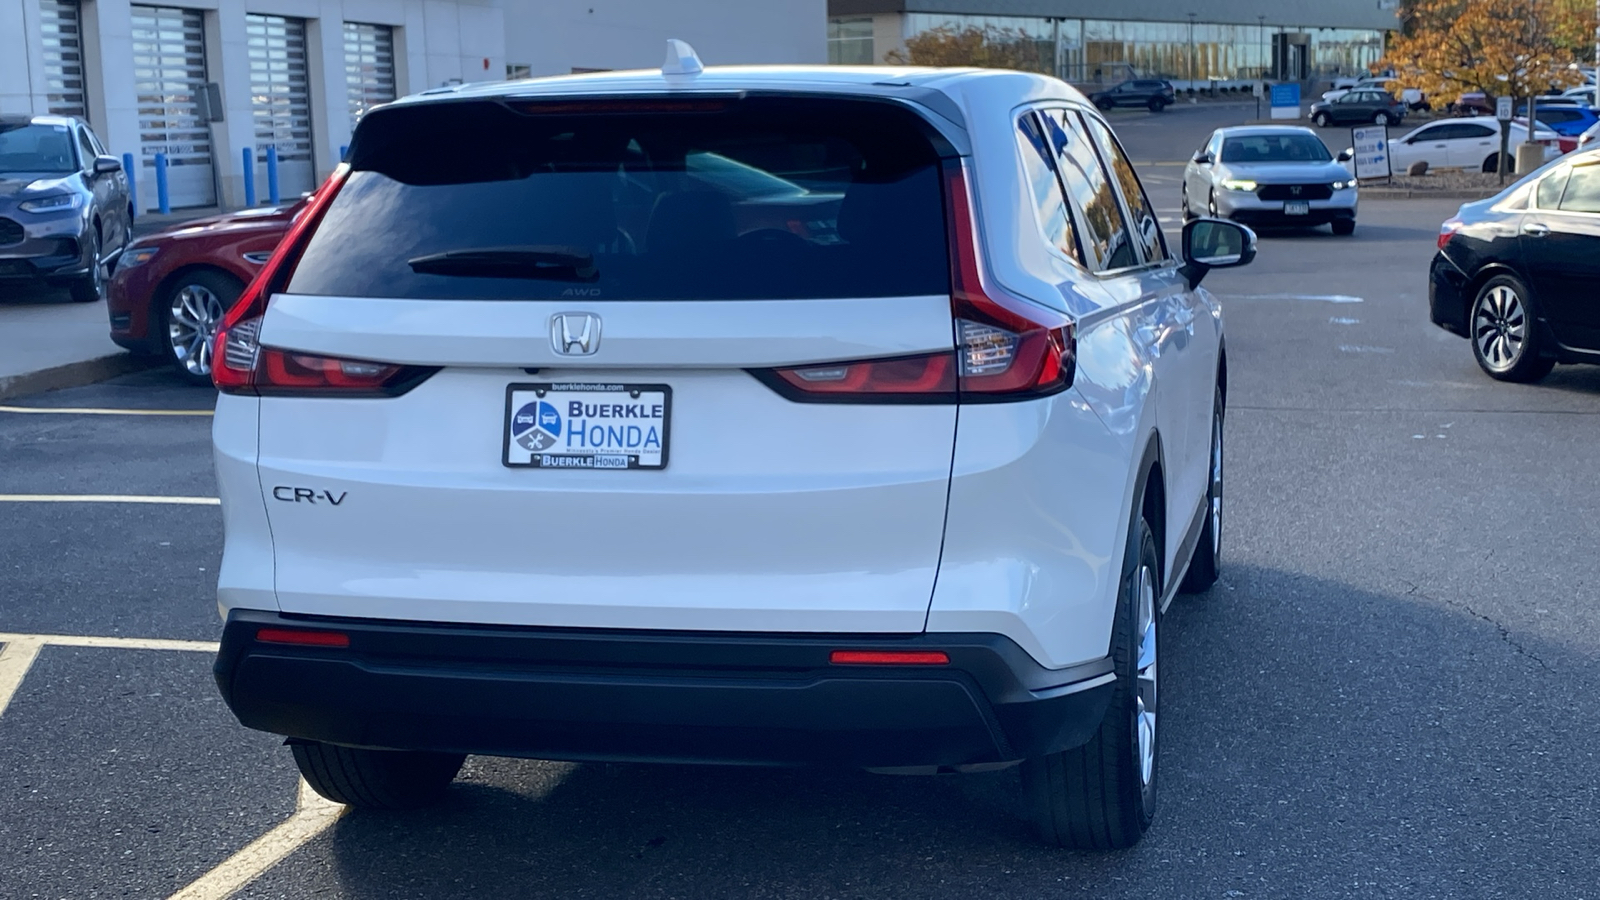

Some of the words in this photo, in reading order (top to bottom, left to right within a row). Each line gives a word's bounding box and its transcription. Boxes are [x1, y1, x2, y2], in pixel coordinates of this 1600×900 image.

[562, 288, 601, 297] AWD
[551, 382, 624, 392] buerklehonda.com
[568, 400, 663, 419] BUERKLE
[566, 419, 661, 449] HONDA
[542, 455, 594, 467] BUERKLE
[595, 456, 627, 467] HONDA
[272, 485, 348, 507] CR-V
